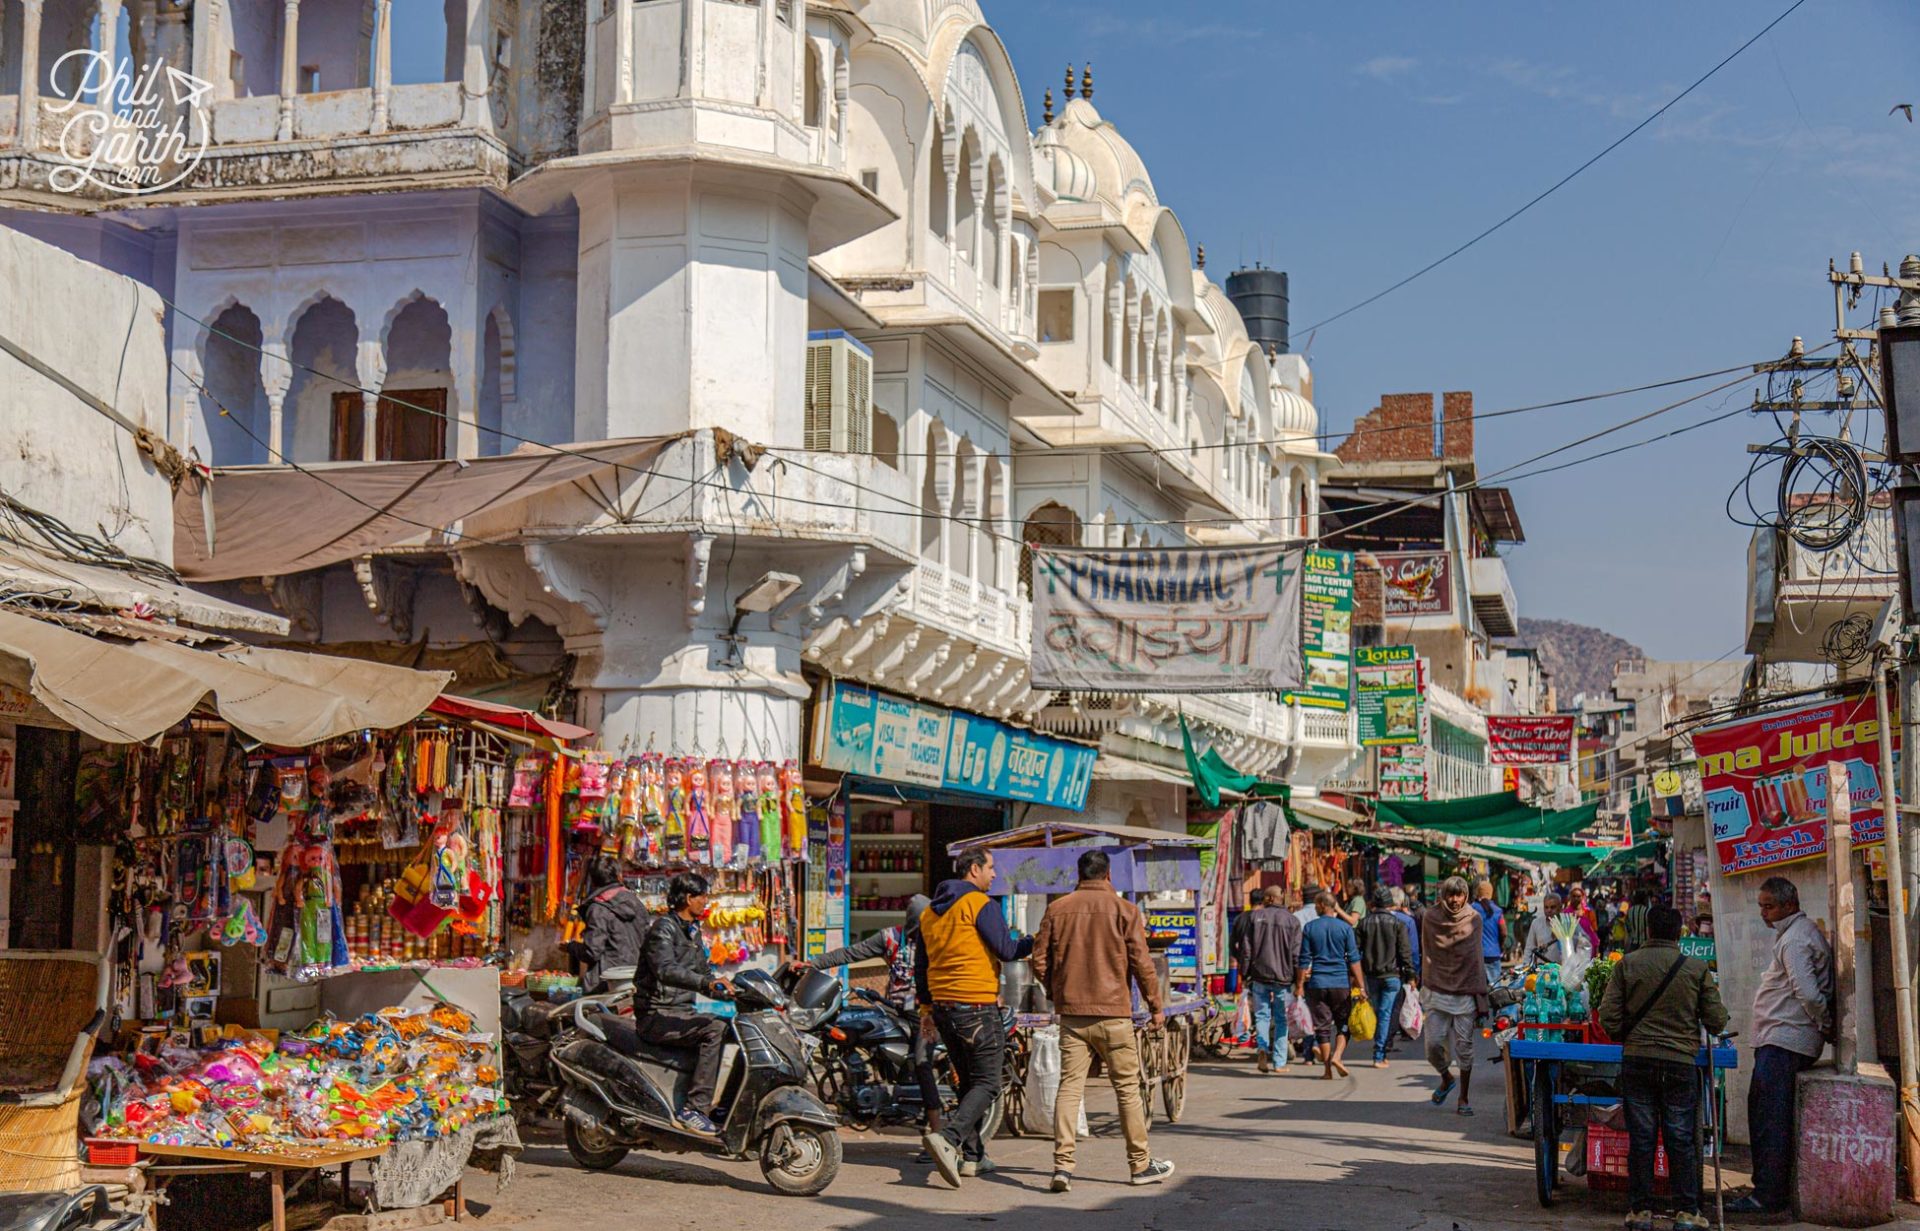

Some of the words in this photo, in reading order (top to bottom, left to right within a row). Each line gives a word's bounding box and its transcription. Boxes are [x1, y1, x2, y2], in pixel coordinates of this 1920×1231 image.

[1323, 577, 1352, 587] CENTER
[1305, 584, 1328, 594] EAUTY
[1328, 588, 1348, 597] CARE
[1358, 648, 1409, 665] Lotus
[1762, 717, 1796, 732] Brahma
[1797, 709, 1834, 726] Pushkar
[1501, 727, 1532, 740] Little
[1534, 727, 1570, 740] Tibet
[1769, 720, 1880, 763] Juice
[1734, 830, 1815, 858] Fresh
[1149, 916, 1196, 927] नटराज
[1678, 941, 1715, 957] isleri
